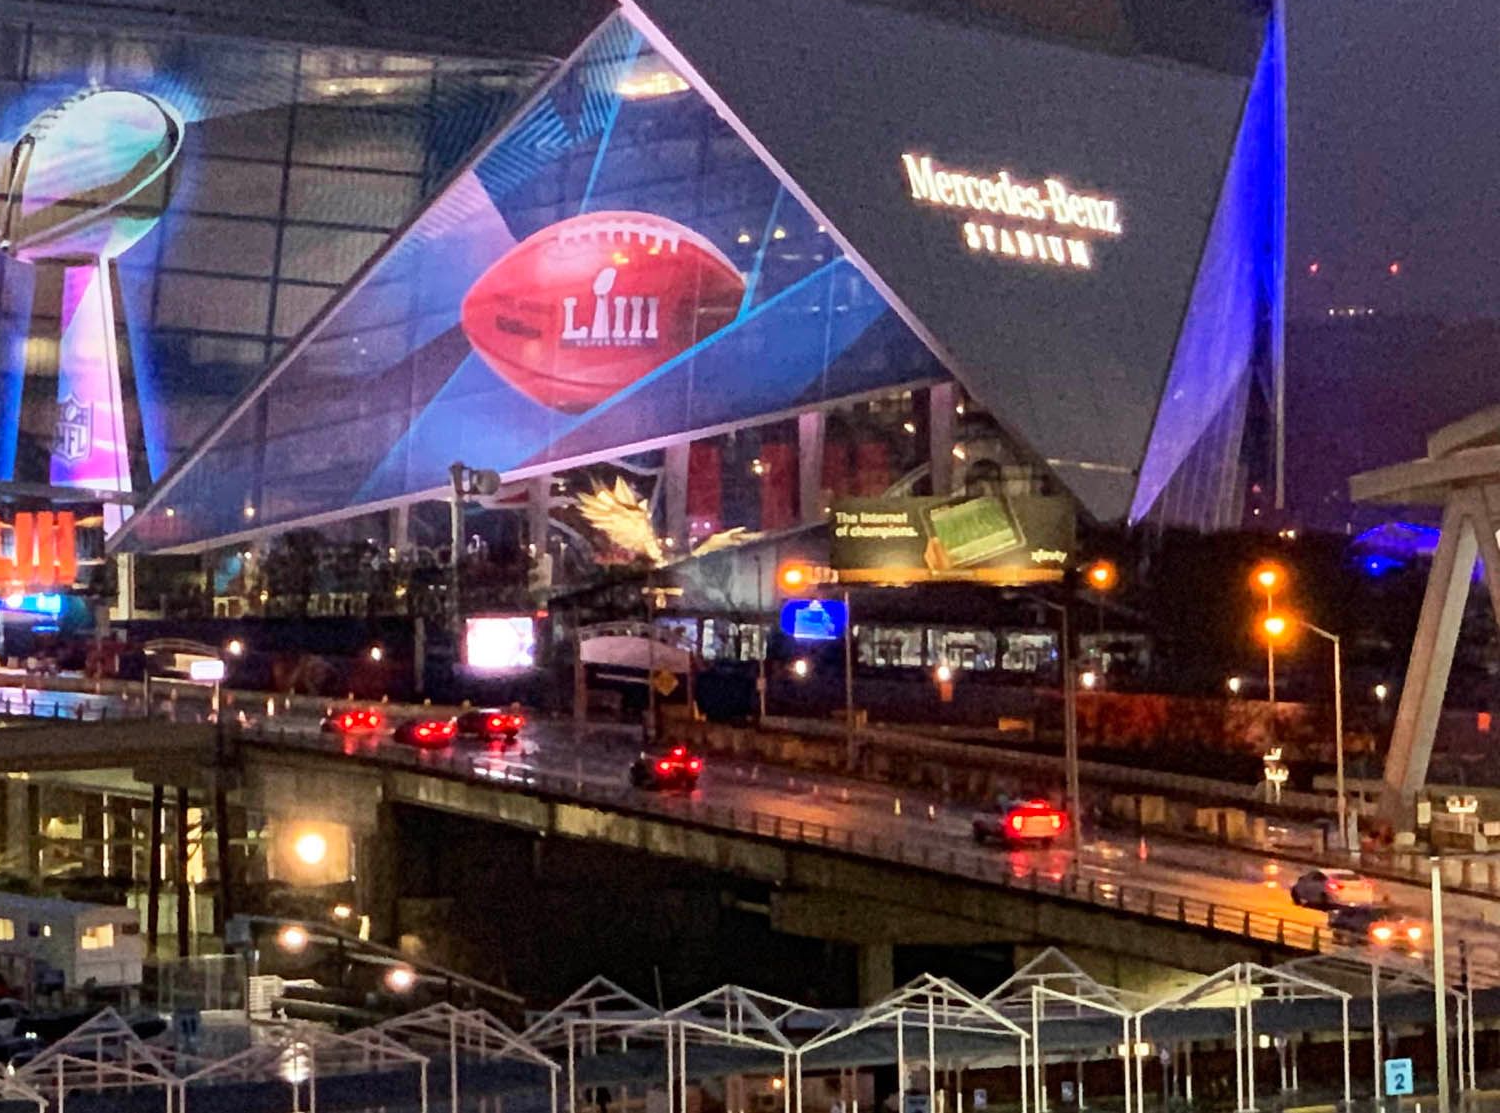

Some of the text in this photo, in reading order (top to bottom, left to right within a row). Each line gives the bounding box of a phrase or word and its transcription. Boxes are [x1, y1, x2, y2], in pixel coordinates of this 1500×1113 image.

[901, 153, 1122, 234] Mercedes-Benz
[963, 221, 1091, 269] STADIUM
[561, 283, 659, 339] LIII
[1394, 1072, 1406, 1091] 2
